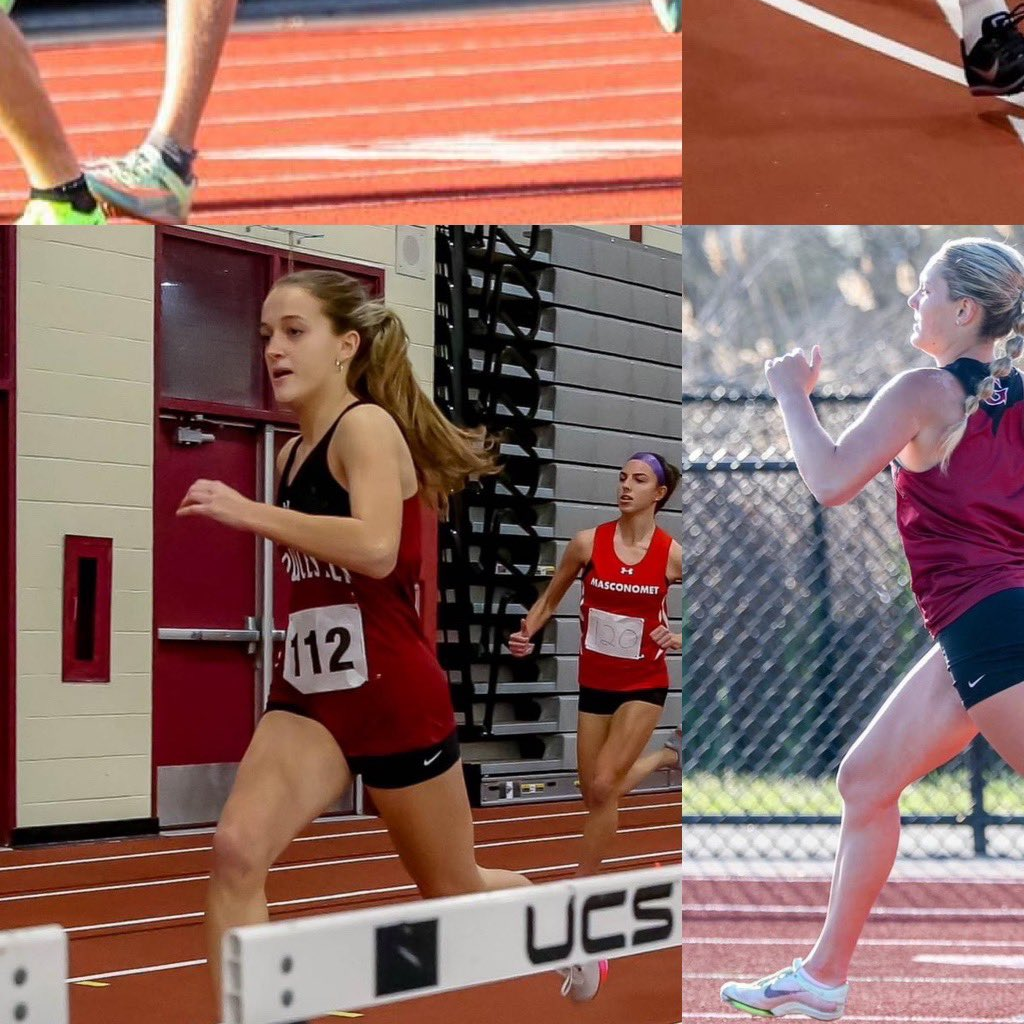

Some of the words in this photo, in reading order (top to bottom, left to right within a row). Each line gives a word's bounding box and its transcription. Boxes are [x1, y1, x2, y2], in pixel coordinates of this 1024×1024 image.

[590, 577, 660, 595] MASCONOMET
[291, 627, 355, 677] 112
[526, 883, 673, 965] UCS
